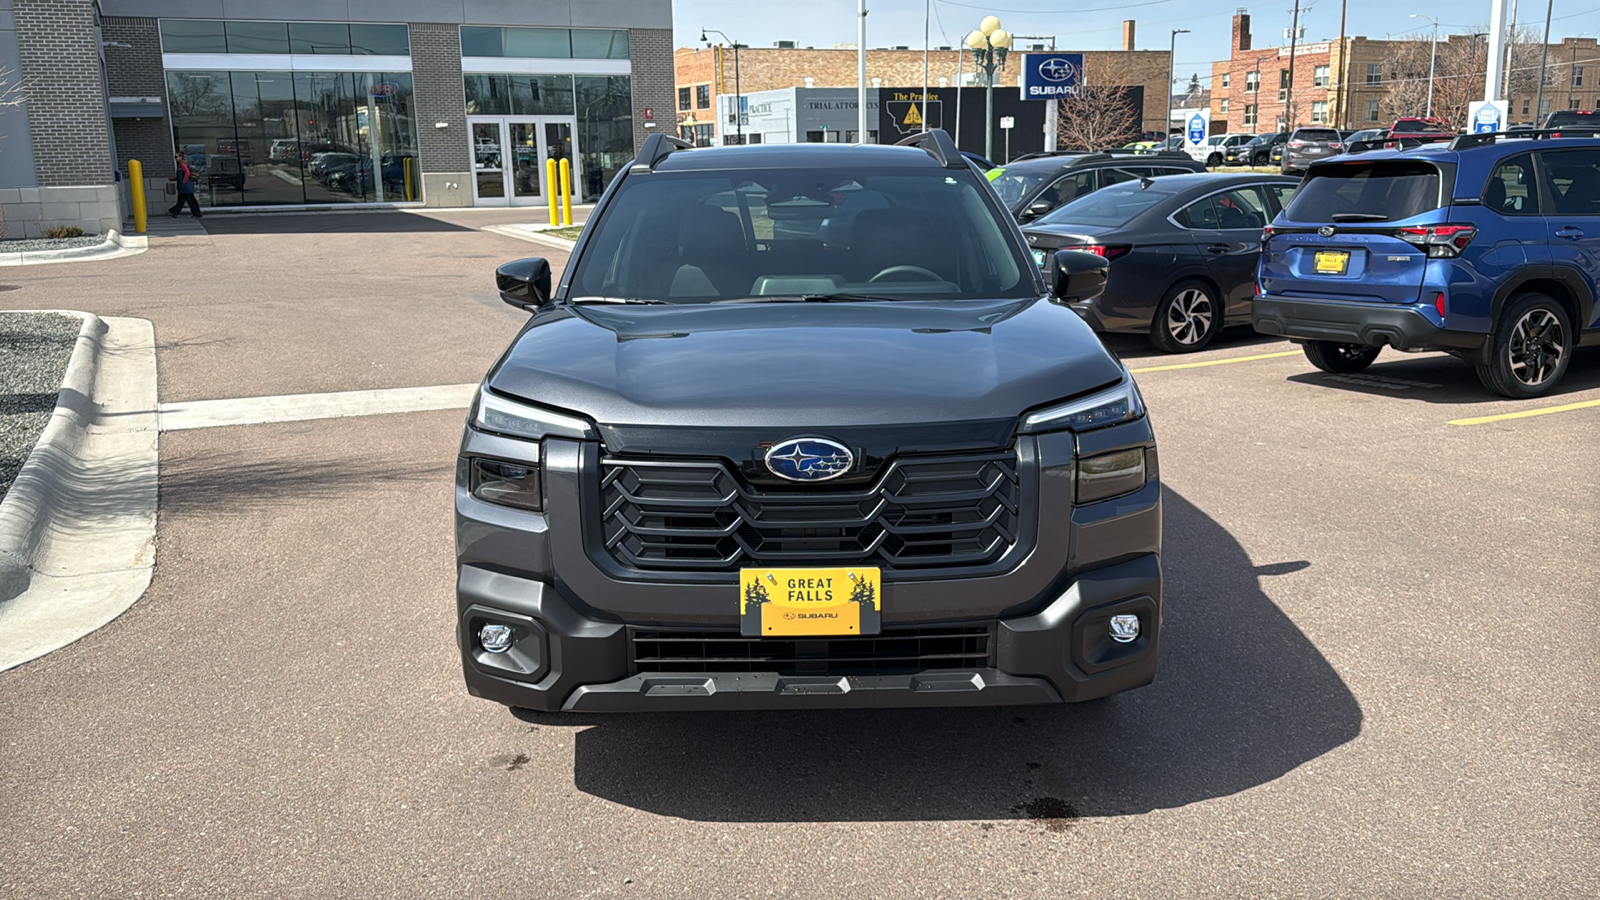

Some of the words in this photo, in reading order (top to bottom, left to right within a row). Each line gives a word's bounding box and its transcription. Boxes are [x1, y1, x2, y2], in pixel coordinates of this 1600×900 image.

[1030, 86, 1079, 95] SUBARU
[749, 103, 772, 114] PRACTICE
[809, 102, 833, 110] TRIAL
[834, 101, 879, 110] ATTOREYS
[788, 578, 833, 588] GREAT
[788, 590, 833, 601] FALLS
